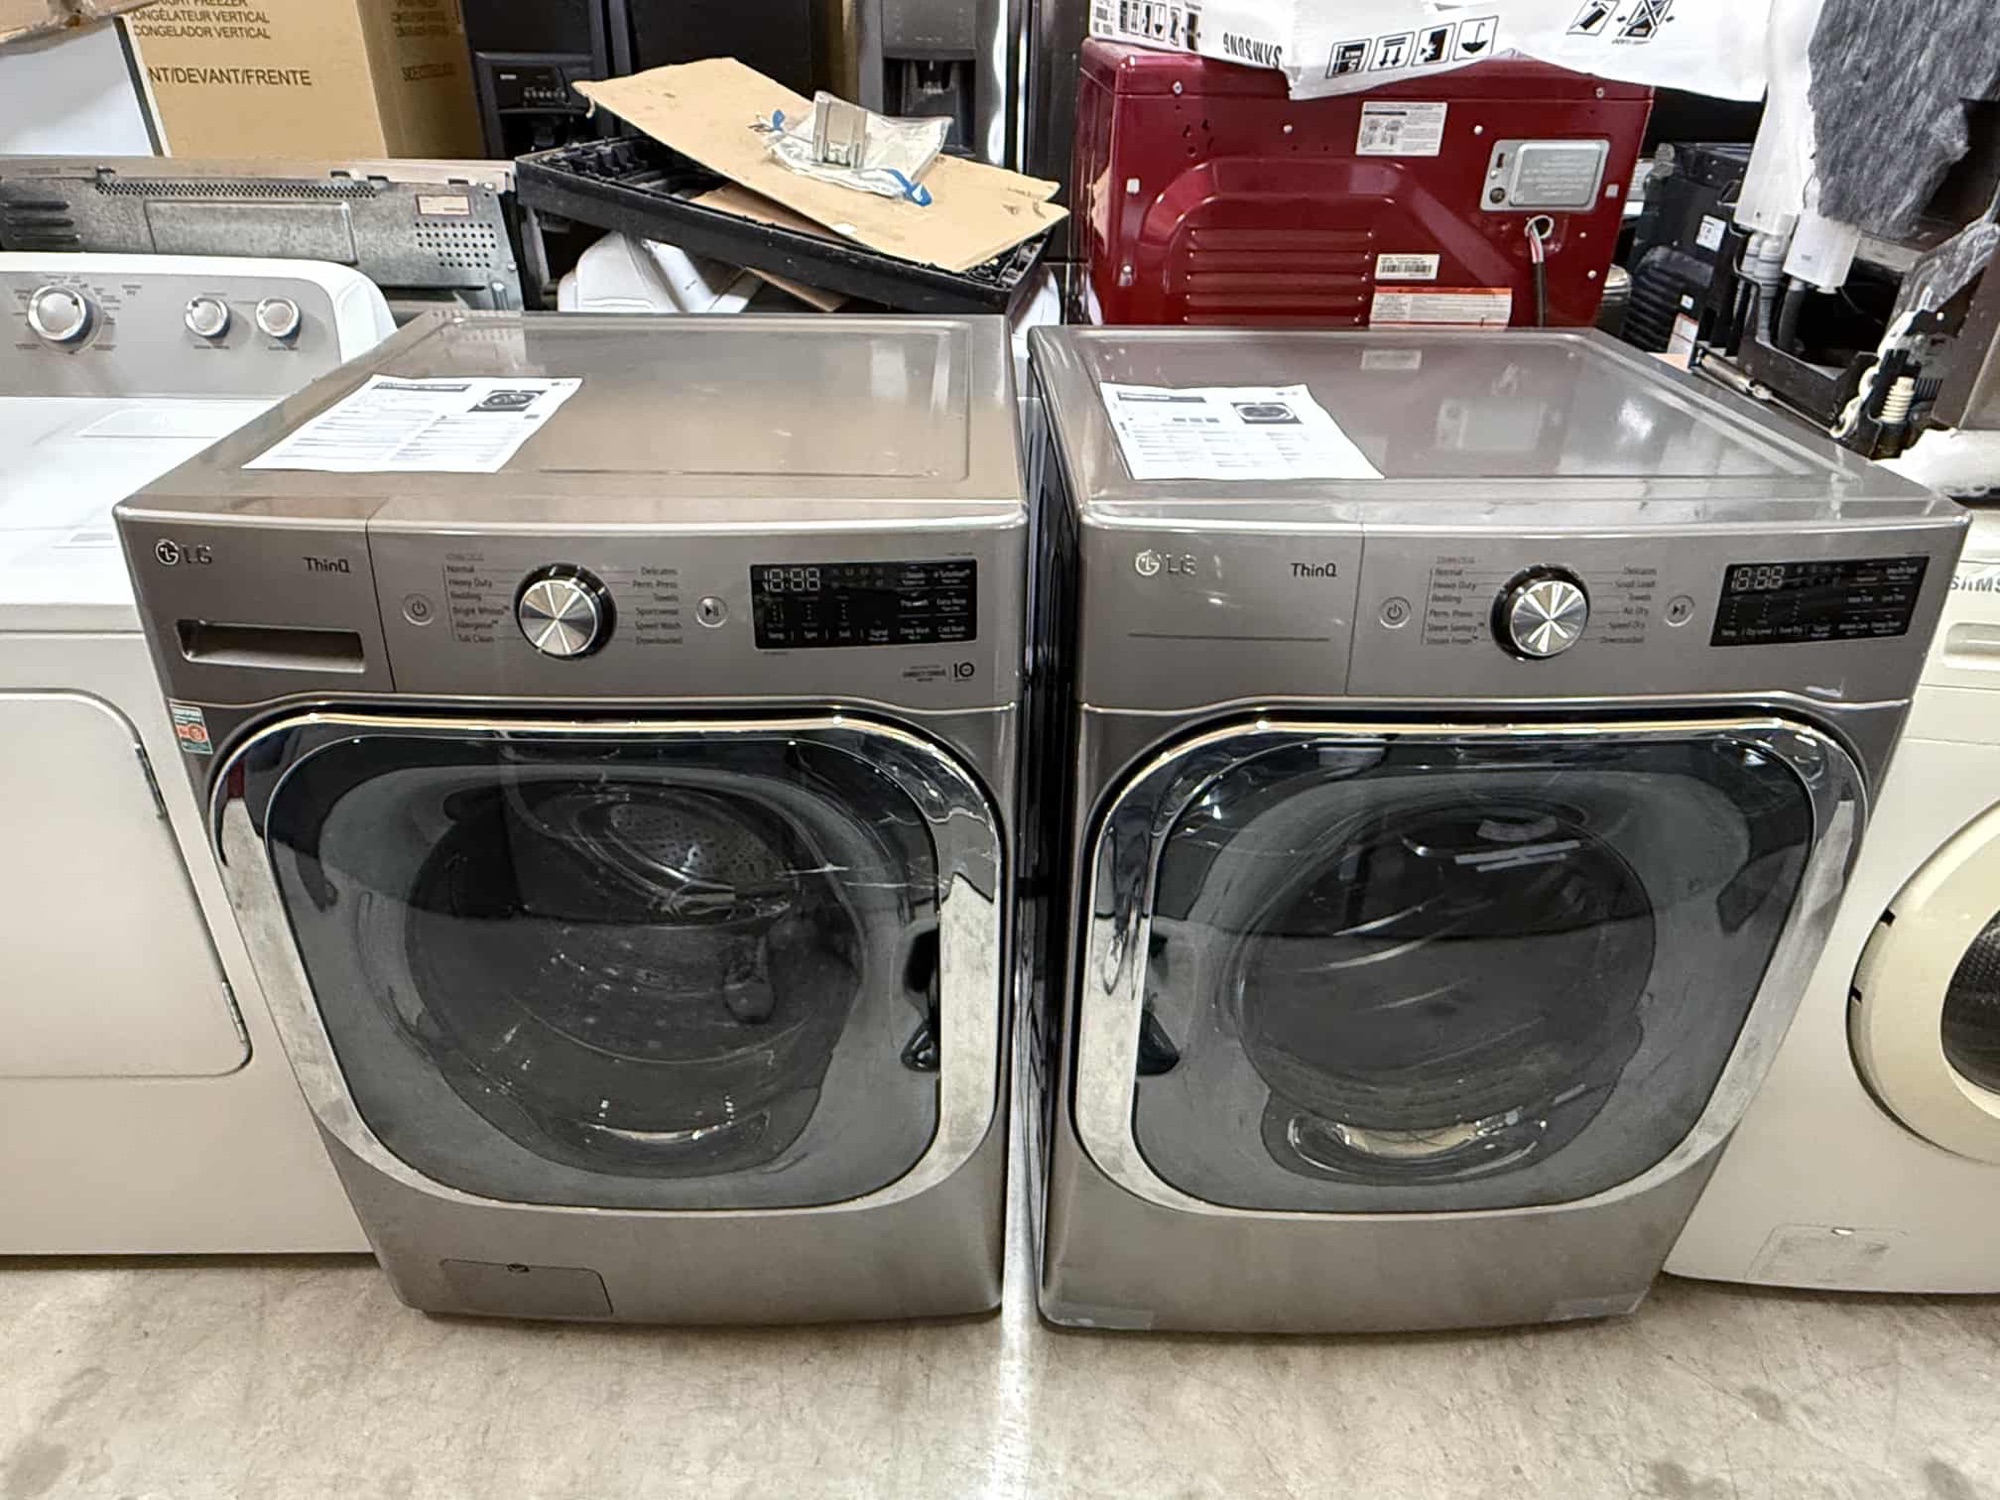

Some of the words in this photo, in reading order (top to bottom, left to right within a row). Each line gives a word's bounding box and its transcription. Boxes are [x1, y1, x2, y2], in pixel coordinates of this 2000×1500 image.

[131, 8, 212, 22] ONGÉLATEUR
[213, 10, 270, 24] VERTICAL
[133, 25, 213, 38] CONGELADOR
[214, 26, 270, 39] VERTICAL
[1223, 32, 1283, 70] SAMSUNG
[149, 67, 312, 86] NT/DEVANT/FRENTE
[303, 555, 351, 574] ThinQ
[1290, 561, 1337, 579] ThinQ
